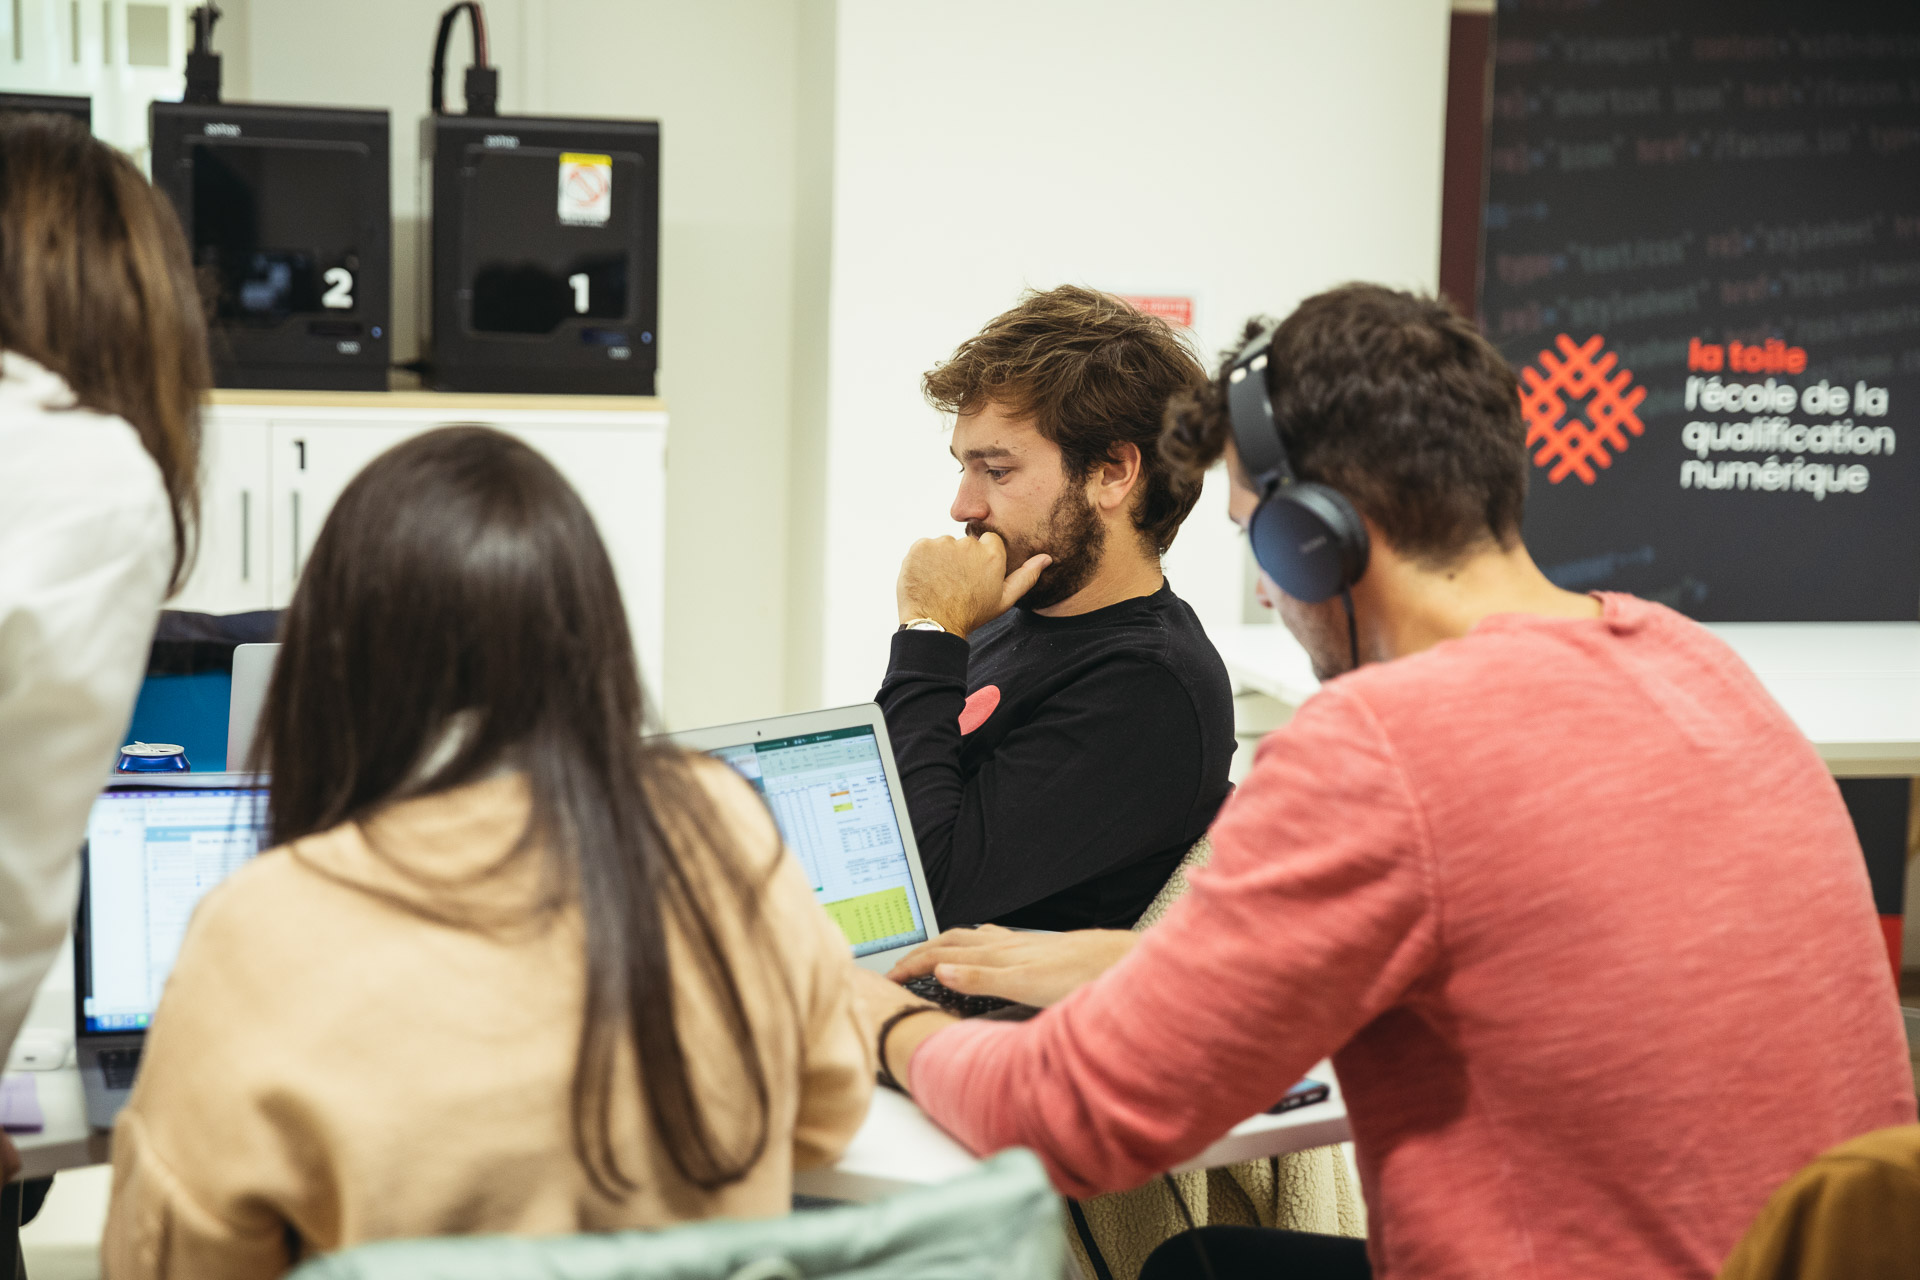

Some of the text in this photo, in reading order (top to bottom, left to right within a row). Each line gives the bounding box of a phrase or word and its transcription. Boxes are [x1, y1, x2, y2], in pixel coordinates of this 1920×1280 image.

[322, 267, 354, 309] 2
[568, 272, 590, 314] 1
[1687, 337, 1724, 373] la
[1728, 337, 1808, 375] toile
[1684, 374, 1889, 417] l'école de la
[293, 438, 306, 471] 1
[1681, 416, 1896, 460] qualification
[1680, 454, 1870, 501] numérique
